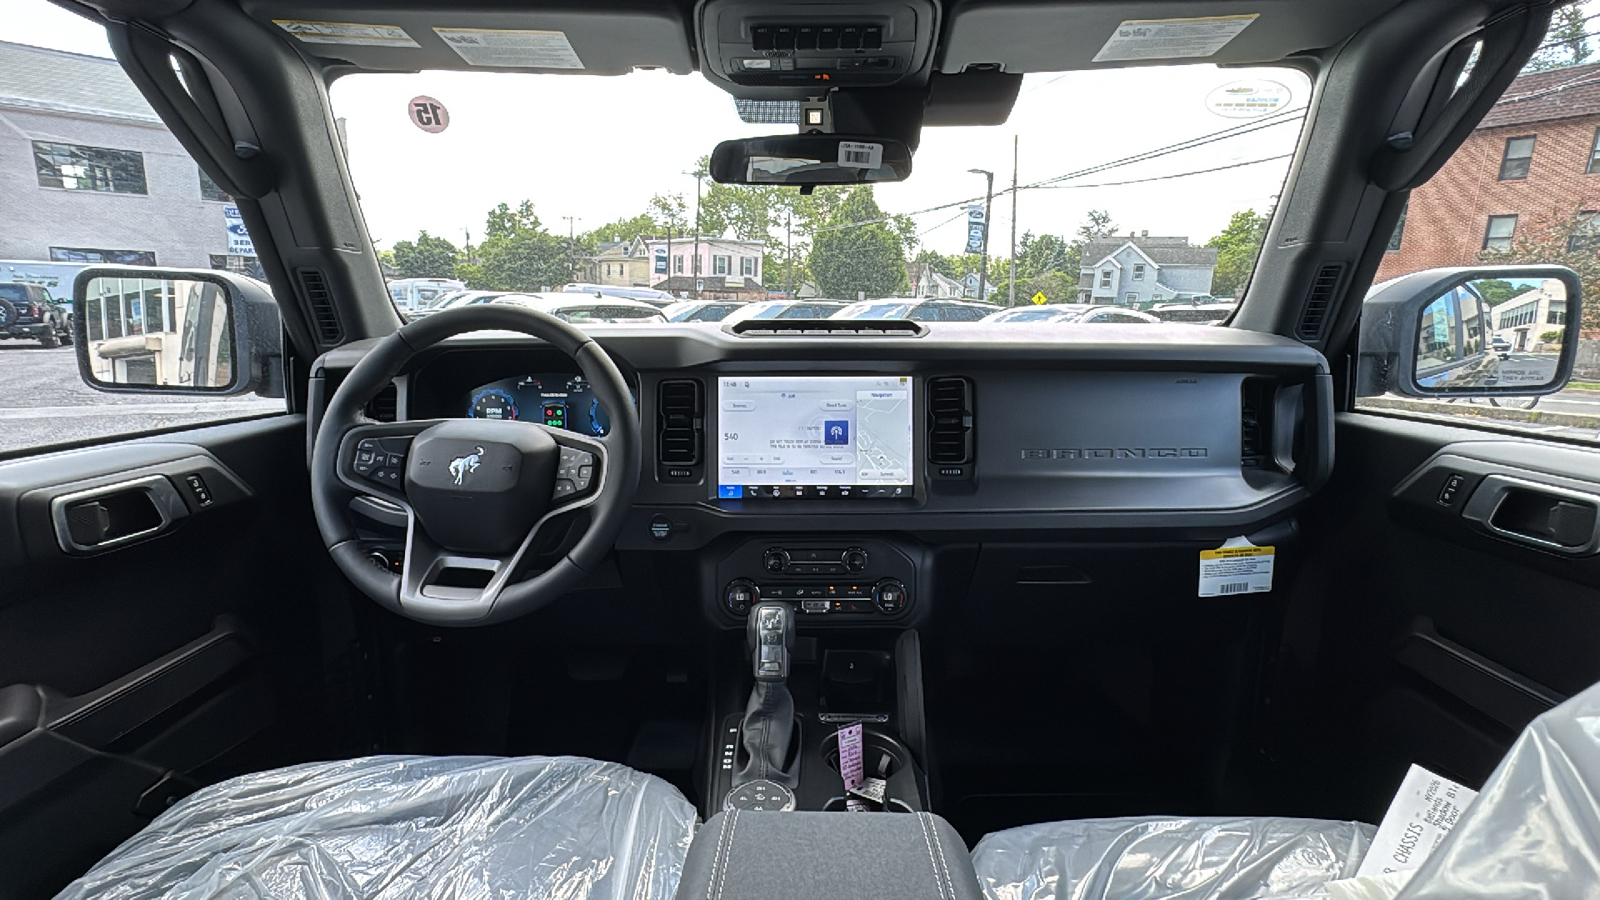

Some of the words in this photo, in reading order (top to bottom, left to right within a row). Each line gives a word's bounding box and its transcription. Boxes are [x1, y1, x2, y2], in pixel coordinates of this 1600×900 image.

[1021, 448, 1208, 459] BRONCO
[1433, 801, 1452, 828] Shadow
[1393, 822, 1424, 864] CHASSIS
